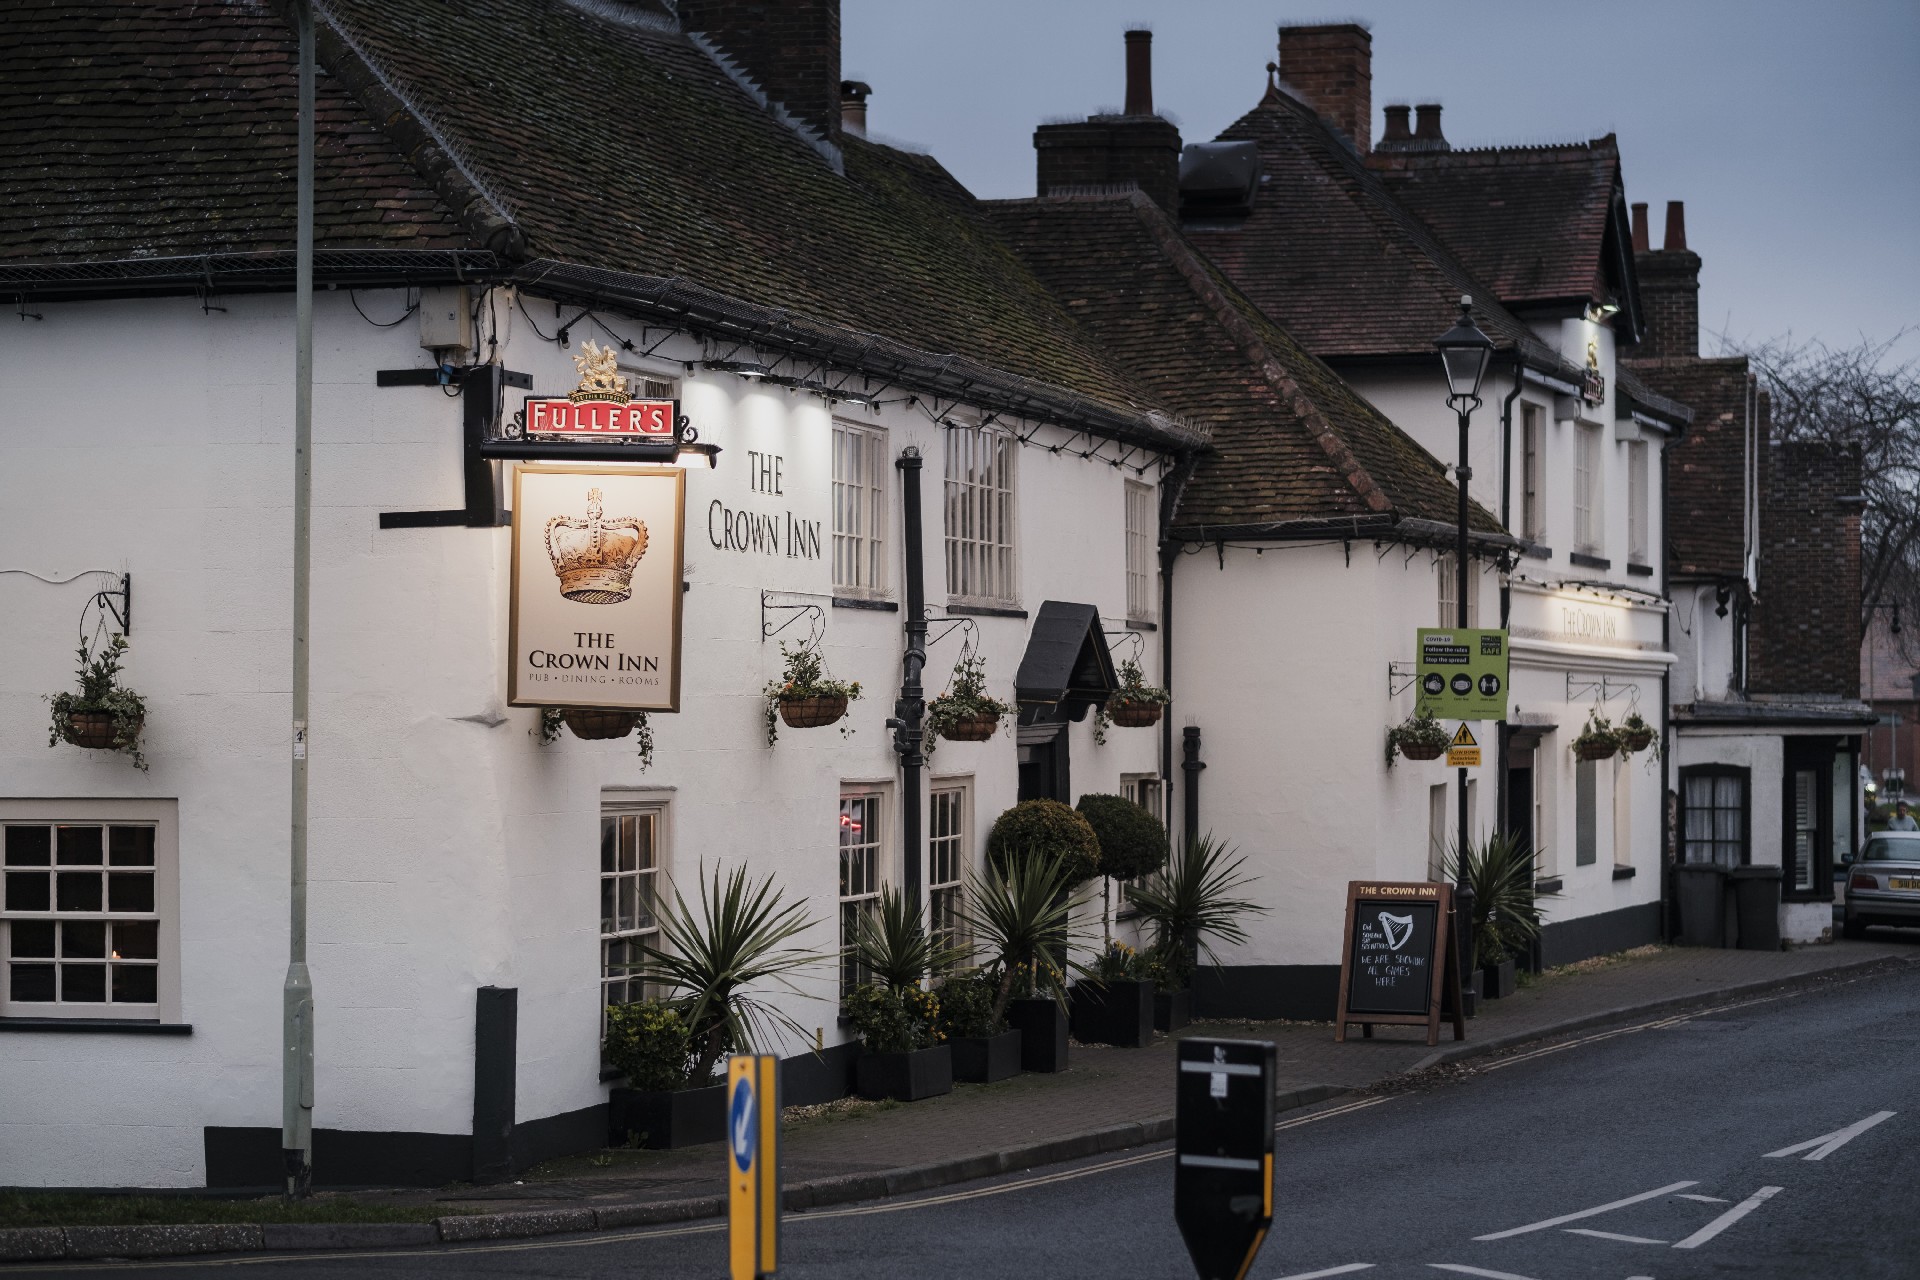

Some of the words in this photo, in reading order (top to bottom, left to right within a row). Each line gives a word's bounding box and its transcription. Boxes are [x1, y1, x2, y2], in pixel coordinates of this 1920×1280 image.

[533, 403, 664, 433] FULLER'S
[748, 450, 783, 496] THE
[708, 499, 778, 554] CROWN
[786, 510, 821, 560] INN
[1562, 607, 1576, 637] THE
[1577, 608, 1601, 638] CROWN
[1603, 610, 1616, 639] INN
[574, 632, 615, 649] THE
[1482, 647, 1500, 655] SAFE
[529, 649, 609, 670] CROWN
[618, 653, 659, 672] INN
[529, 673, 549, 682] PUB
[562, 674, 606, 684] DINING
[618, 676, 659, 686] ROOMS
[1360, 886, 1377, 895] THE
[1380, 887, 1416, 896] CROWN
[1419, 887, 1437, 896] INN
[1361, 955, 1372, 964] WE
[1374, 954, 1389, 964] ARE
[1385, 965, 1410, 976] GAMES
[1375, 976, 1396, 987] HERE
